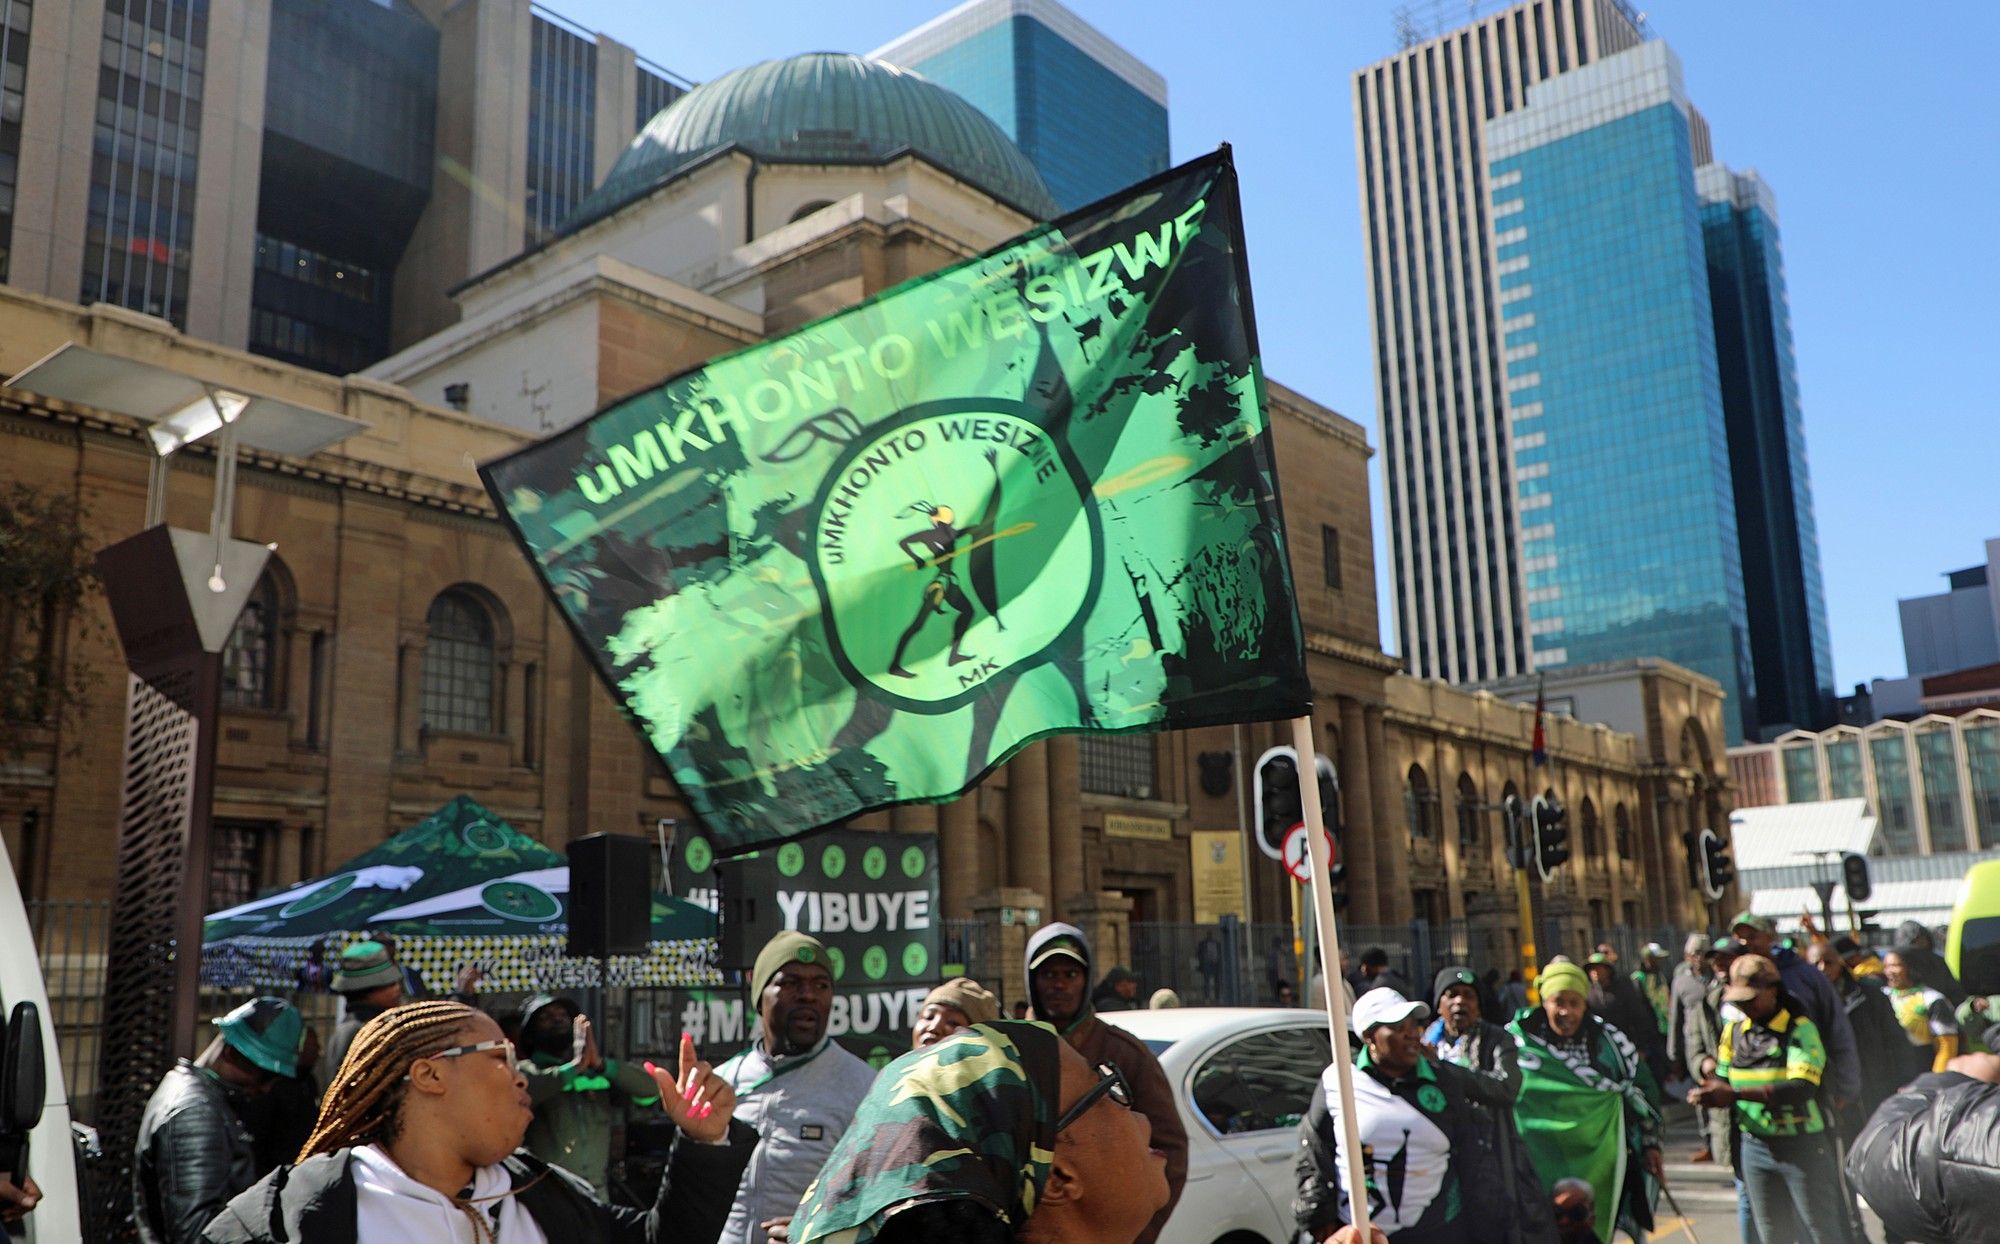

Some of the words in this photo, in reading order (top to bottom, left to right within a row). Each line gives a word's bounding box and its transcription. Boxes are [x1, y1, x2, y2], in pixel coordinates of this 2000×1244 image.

[575, 333, 915, 505] uMKHONTO
[822, 429, 927, 566] uMKHONTO
[958, 655, 1001, 689] MK
